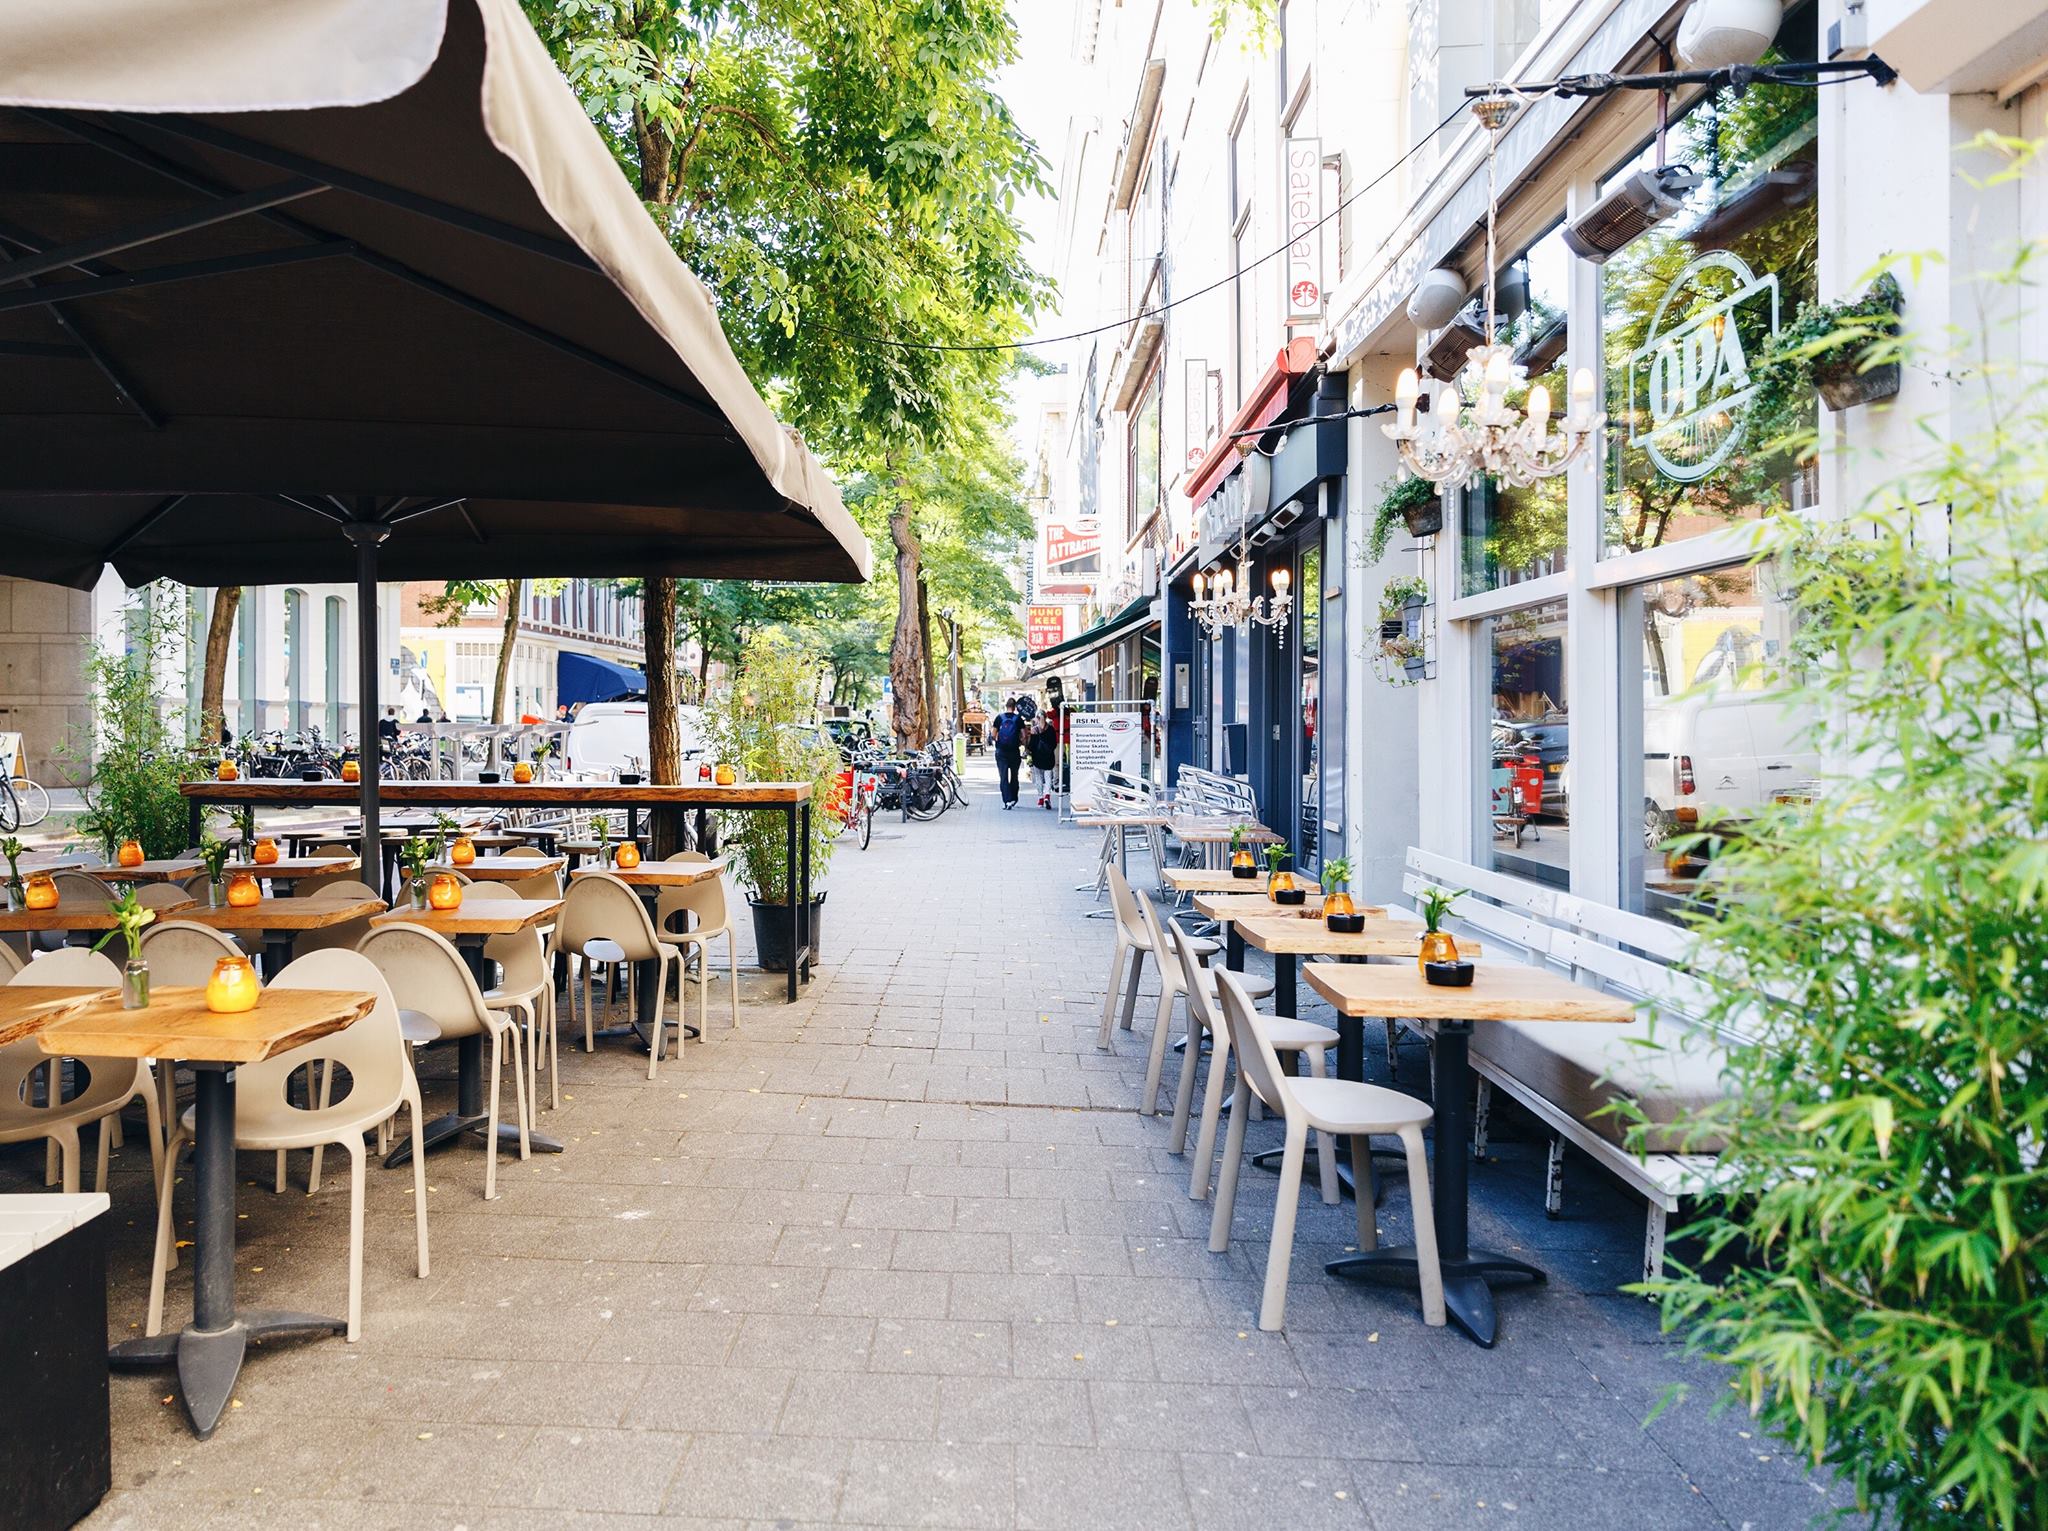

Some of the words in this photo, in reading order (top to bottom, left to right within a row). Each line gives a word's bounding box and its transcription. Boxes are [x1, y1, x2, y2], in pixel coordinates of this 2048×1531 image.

[1290, 150, 1317, 271] Satebar
[1650, 306, 1752, 421] OPA
[1048, 527, 1065, 542] THE
[1030, 608, 1062, 617] HUNG
[1035, 617, 1057, 625] KEE
